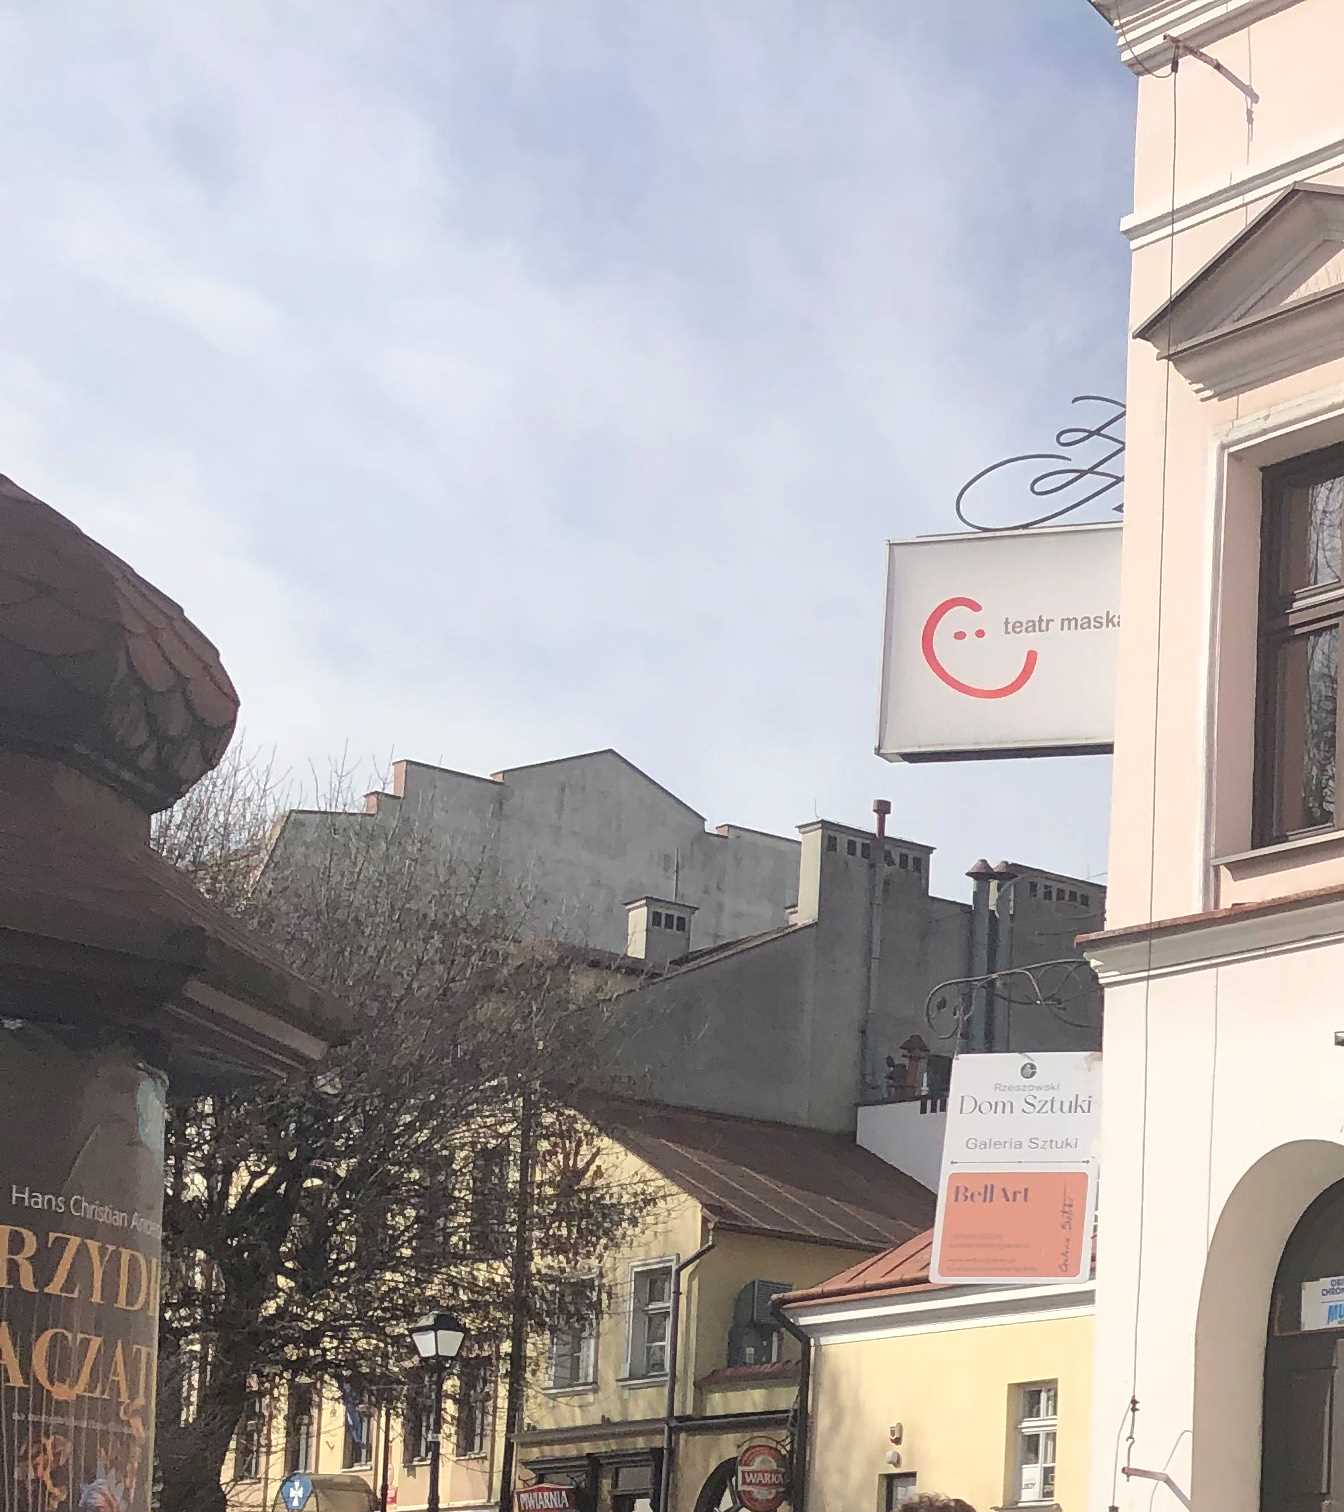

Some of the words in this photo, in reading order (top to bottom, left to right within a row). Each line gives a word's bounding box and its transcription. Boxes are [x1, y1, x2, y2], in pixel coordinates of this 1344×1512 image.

[1003, 615, 1055, 635] teatr
[1060, 610, 1120, 632] mask
[959, 1095, 1015, 1115] Dom
[1021, 1094, 1093, 1115] Sztuki
[965, 1137, 1023, 1150] Galeria
[1028, 1136, 1079, 1150] Sztuki
[11, 1184, 65, 1213] Hans
[70, 1195, 128, 1227] Christian
